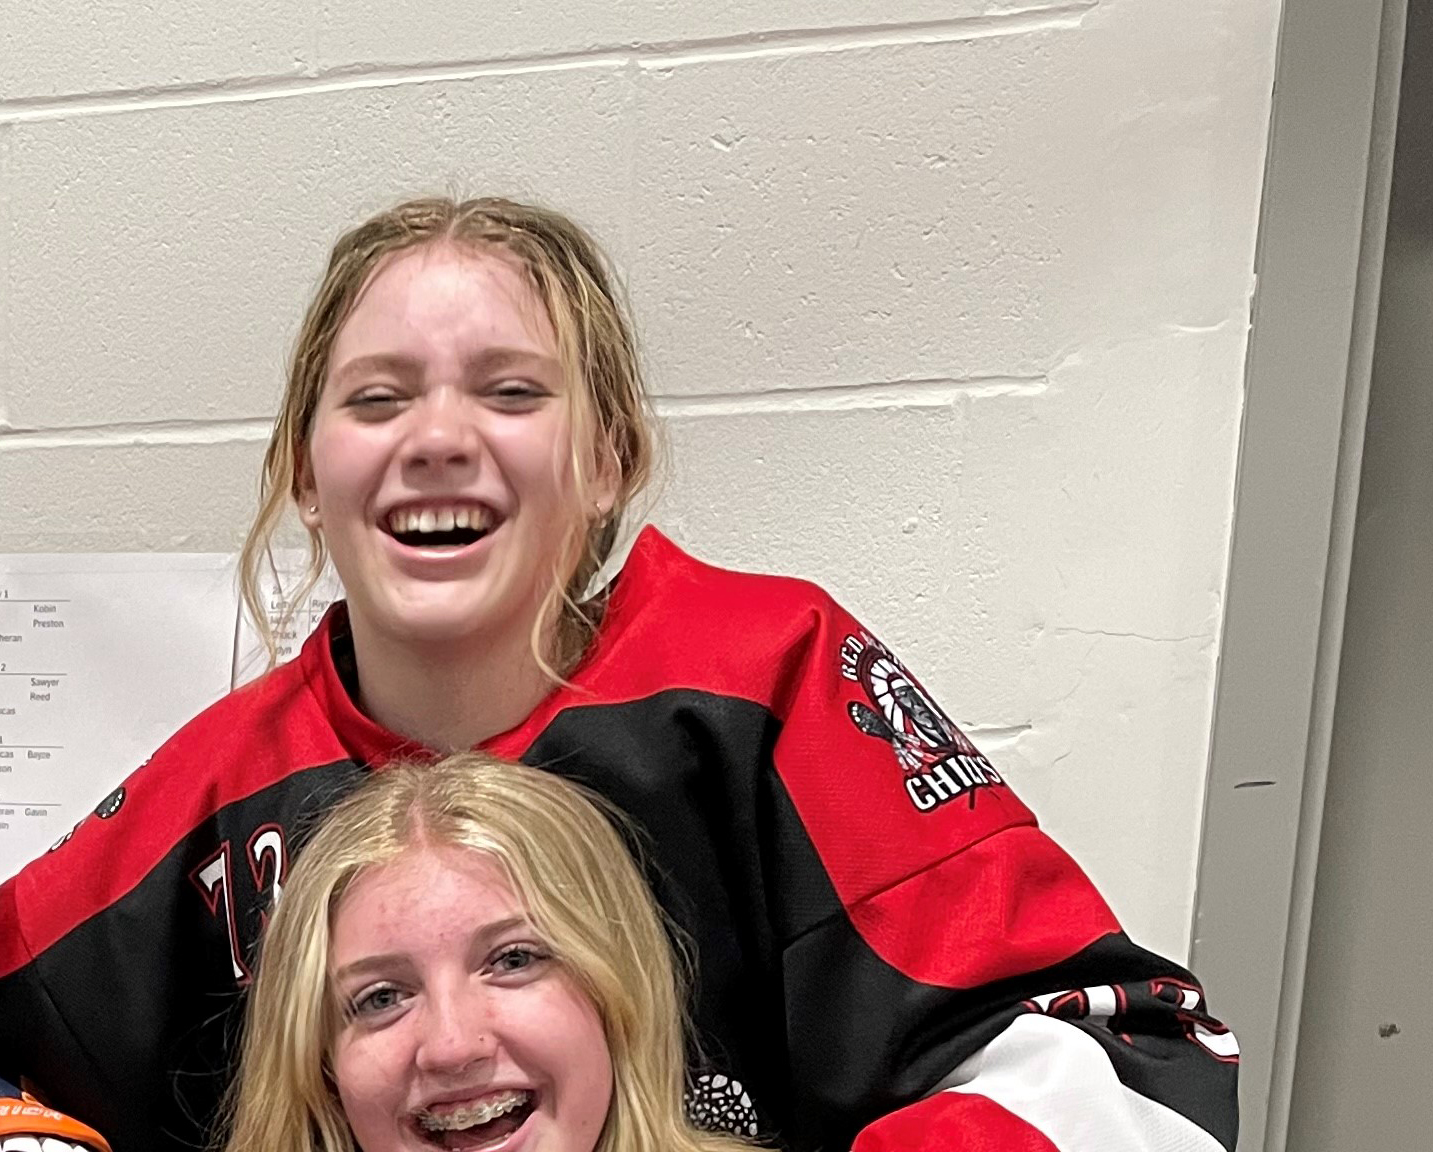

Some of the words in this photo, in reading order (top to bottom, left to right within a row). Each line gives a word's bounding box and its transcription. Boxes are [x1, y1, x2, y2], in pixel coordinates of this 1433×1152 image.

[32, 618, 65, 628] Preston
[0, 663, 6, 672] 2
[30, 677, 59, 688] Sawyer
[30, 692, 51, 701] Reed
